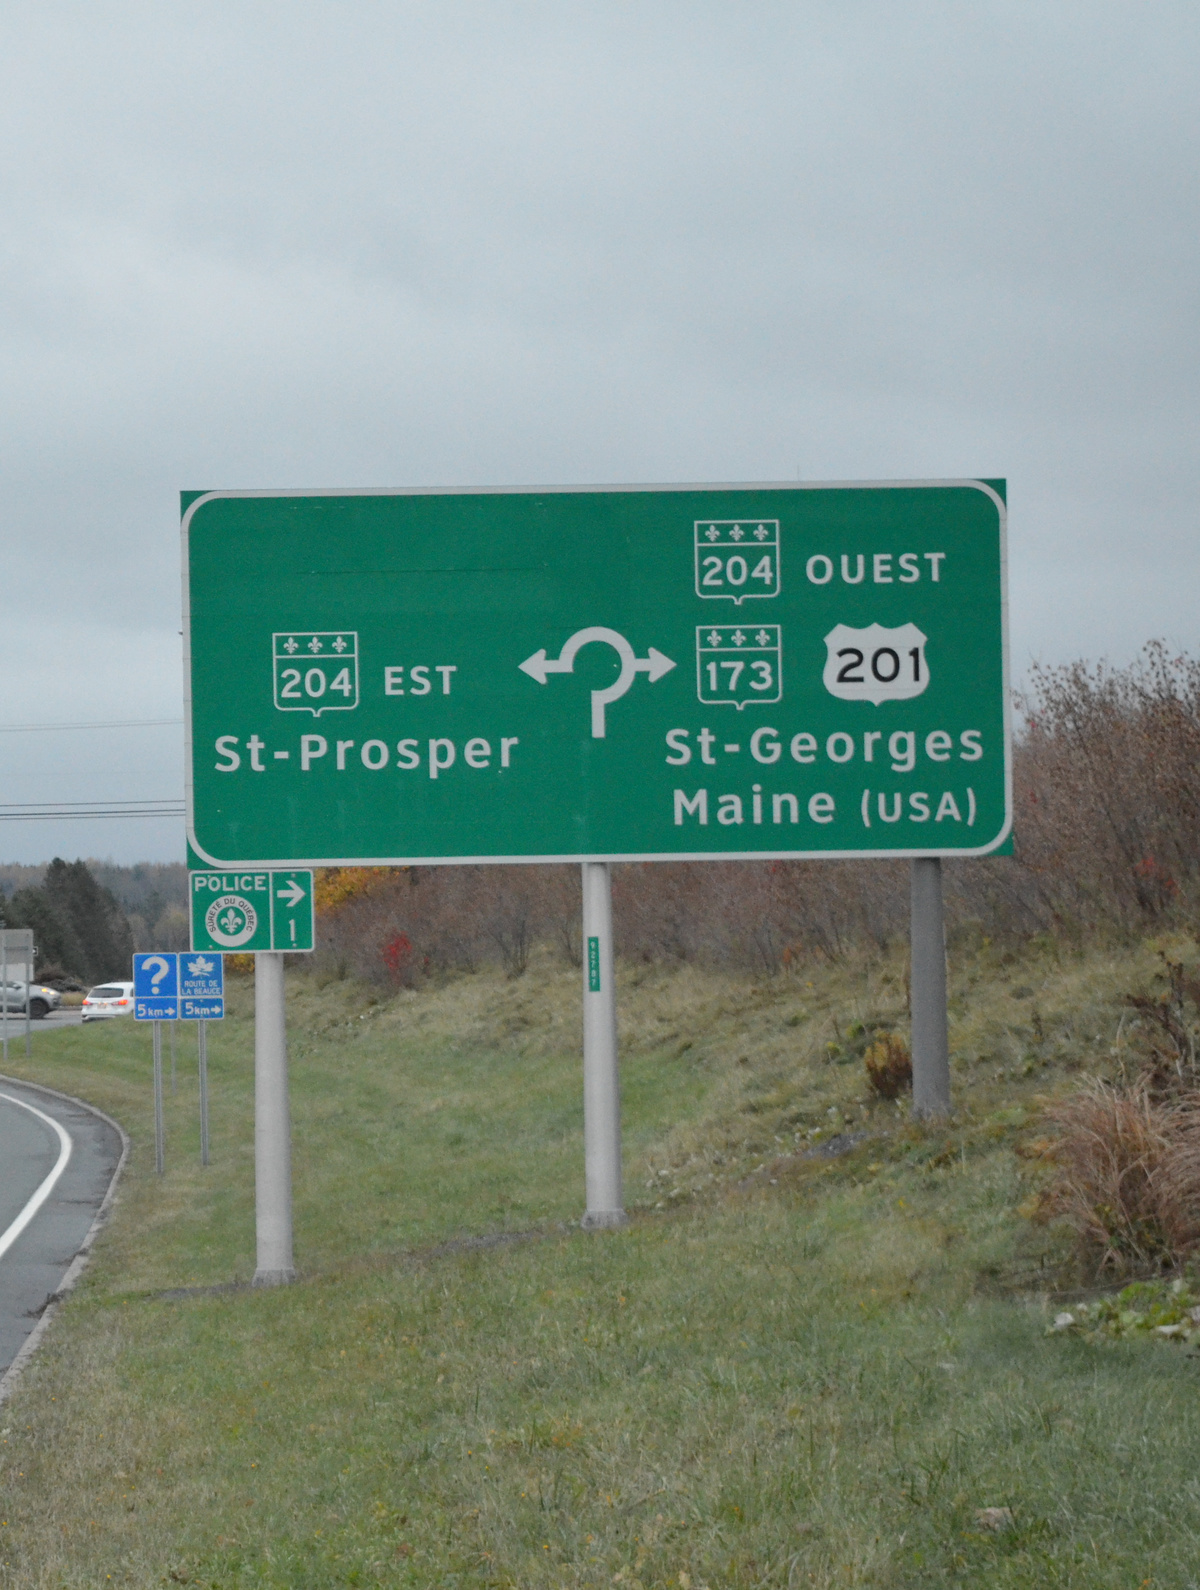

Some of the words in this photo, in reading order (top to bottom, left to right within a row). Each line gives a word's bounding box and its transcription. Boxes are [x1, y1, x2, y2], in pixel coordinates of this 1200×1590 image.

[703, 556, 773, 586] 204
[806, 552, 946, 584] OUEST
[281, 668, 352, 698] 204
[385, 666, 457, 695] EST
[707, 660, 773, 690] 173
[837, 647, 920, 683] 201
[214, 734, 519, 779] St-Prosper
[665, 727, 983, 772] St-Georges
[674, 784, 836, 825] Maine
[861, 787, 976, 828] (USA)
[194, 876, 267, 891] POLICE
[289, 919, 296, 941] 1
